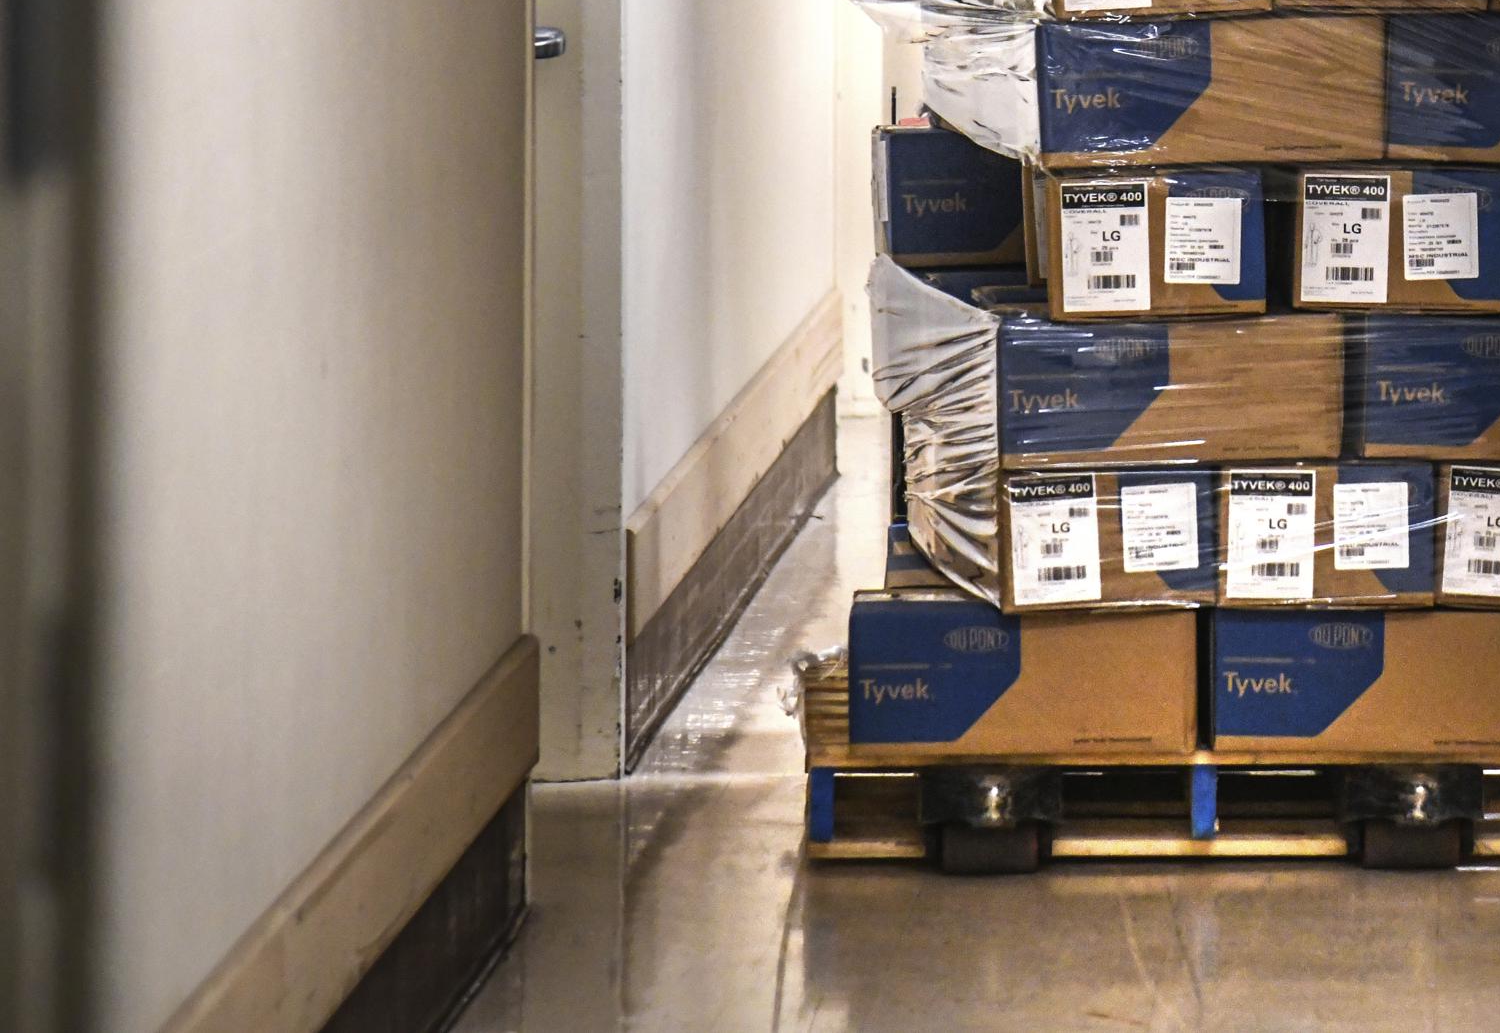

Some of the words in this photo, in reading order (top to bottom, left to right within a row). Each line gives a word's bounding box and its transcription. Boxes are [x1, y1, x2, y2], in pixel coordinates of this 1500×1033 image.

[1399, 81, 1470, 107] Tyvek
[1051, 87, 1121, 115] Tyvek
[1119, 192, 1142, 202] 400
[1363, 186, 1385, 196] 400
[902, 192, 967, 217] Tyvek
[1343, 223, 1362, 234] LG
[1102, 230, 1121, 242] LG
[1376, 380, 1446, 406] Tyvek
[1008, 388, 1080, 414] Tyvek
[1068, 482, 1090, 493] 400
[1288, 480, 1310, 491] 400
[1052, 522, 1071, 534] LG
[1268, 518, 1288, 530] LG
[1222, 670, 1292, 698] Tyvek
[858, 677, 929, 705] Tyvek
